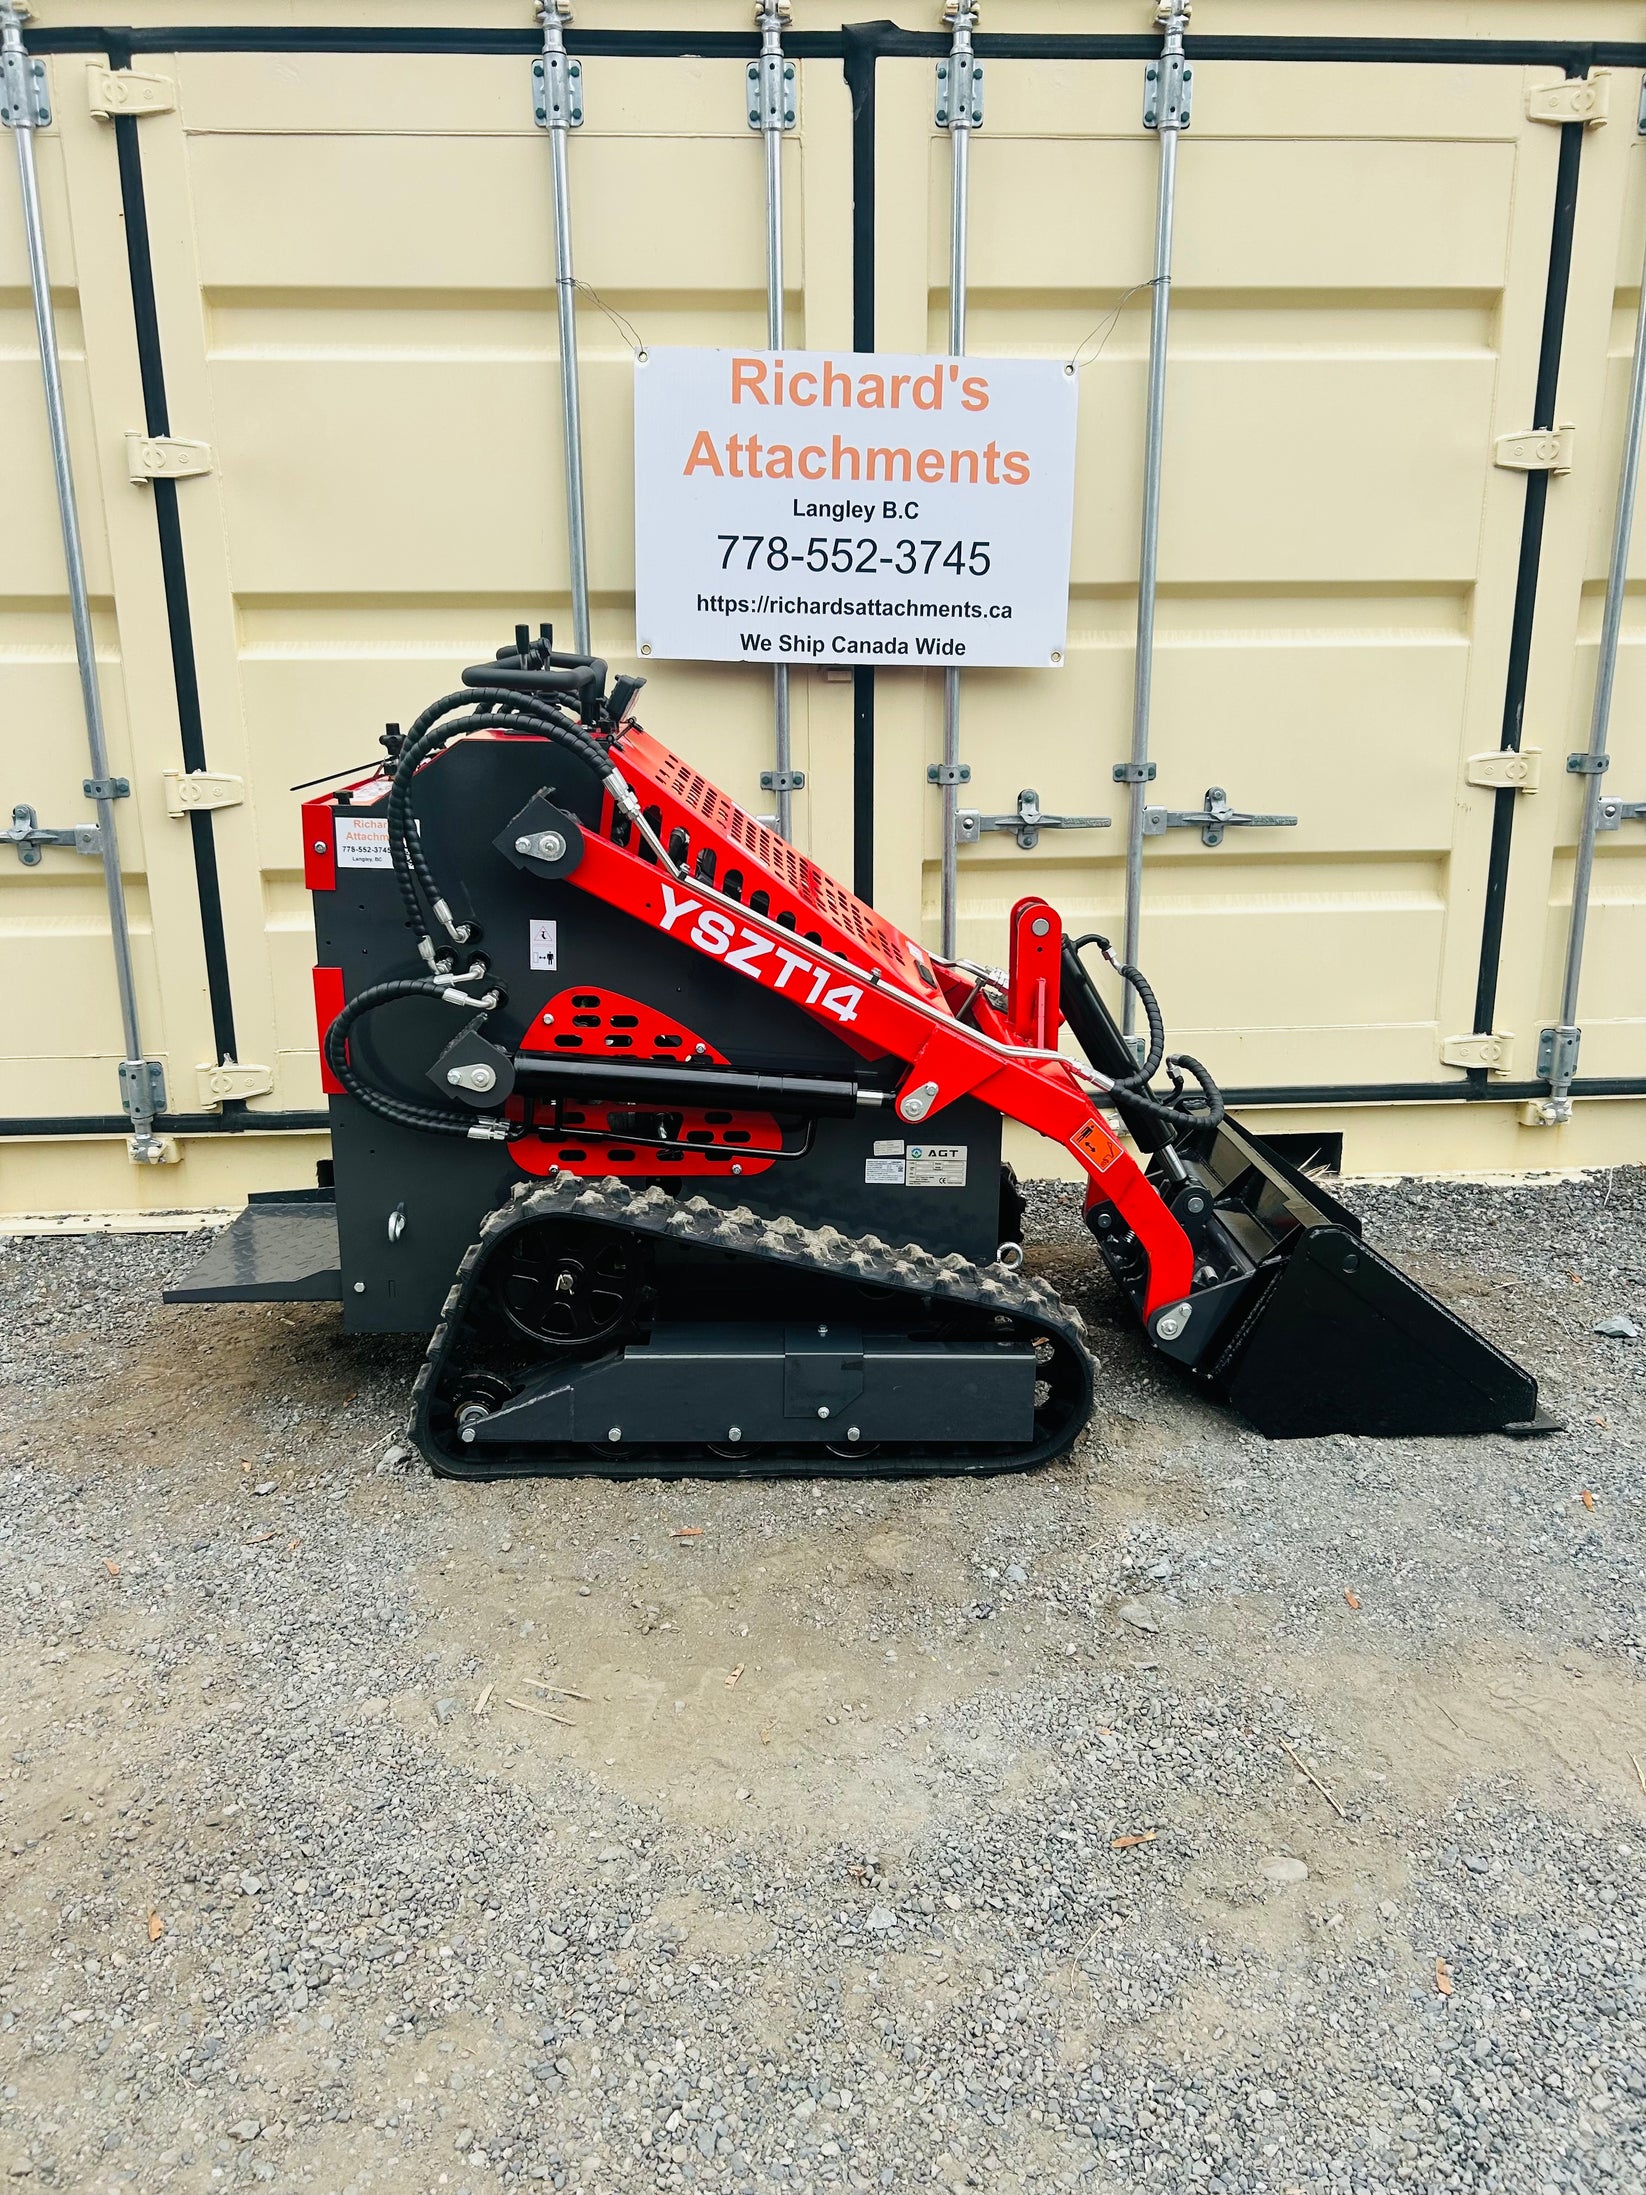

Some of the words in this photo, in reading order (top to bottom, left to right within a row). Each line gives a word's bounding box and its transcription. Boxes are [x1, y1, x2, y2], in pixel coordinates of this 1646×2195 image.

[731, 358, 989, 411] Richard's
[683, 430, 1030, 485] Attachments
[793, 499, 875, 523] Langley
[882, 501, 919, 520] B.C
[717, 534, 991, 576] 778-552-3745
[697, 594, 1012, 619] https://richardsattachments.ca
[740, 633, 772, 652] We
[778, 635, 825, 656] Ship
[831, 636, 909, 655] Canada
[915, 637, 966, 656] Wide
[659, 883, 864, 1022] YSZT14
